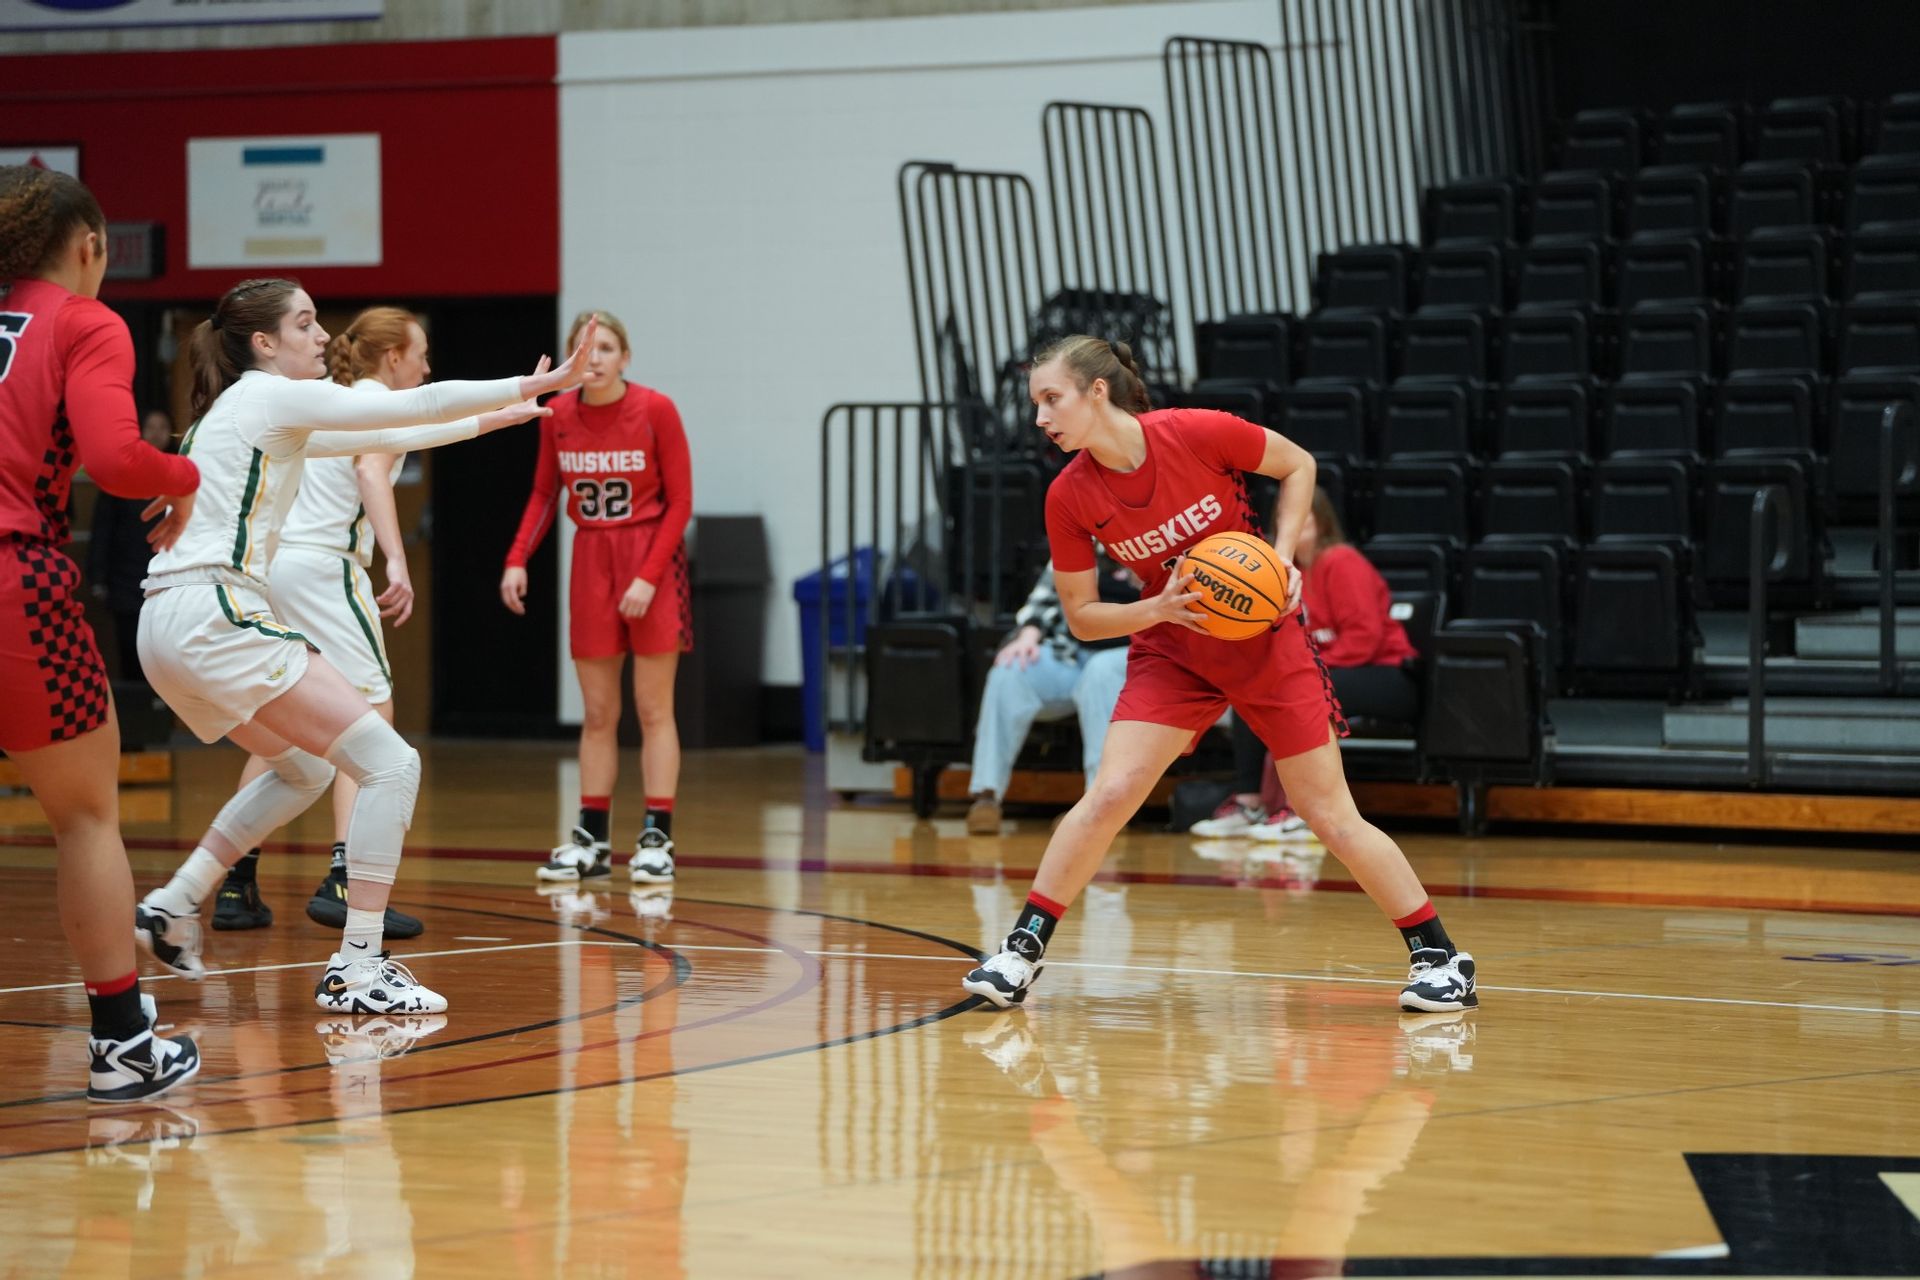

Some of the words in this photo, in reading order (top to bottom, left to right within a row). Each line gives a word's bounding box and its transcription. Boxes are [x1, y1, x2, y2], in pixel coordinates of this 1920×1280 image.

[558, 450, 646, 473] HUSKIES
[573, 478, 632, 520] 32
[1110, 494, 1222, 561] HUSKIES
[1193, 566, 1253, 615] Wilson
